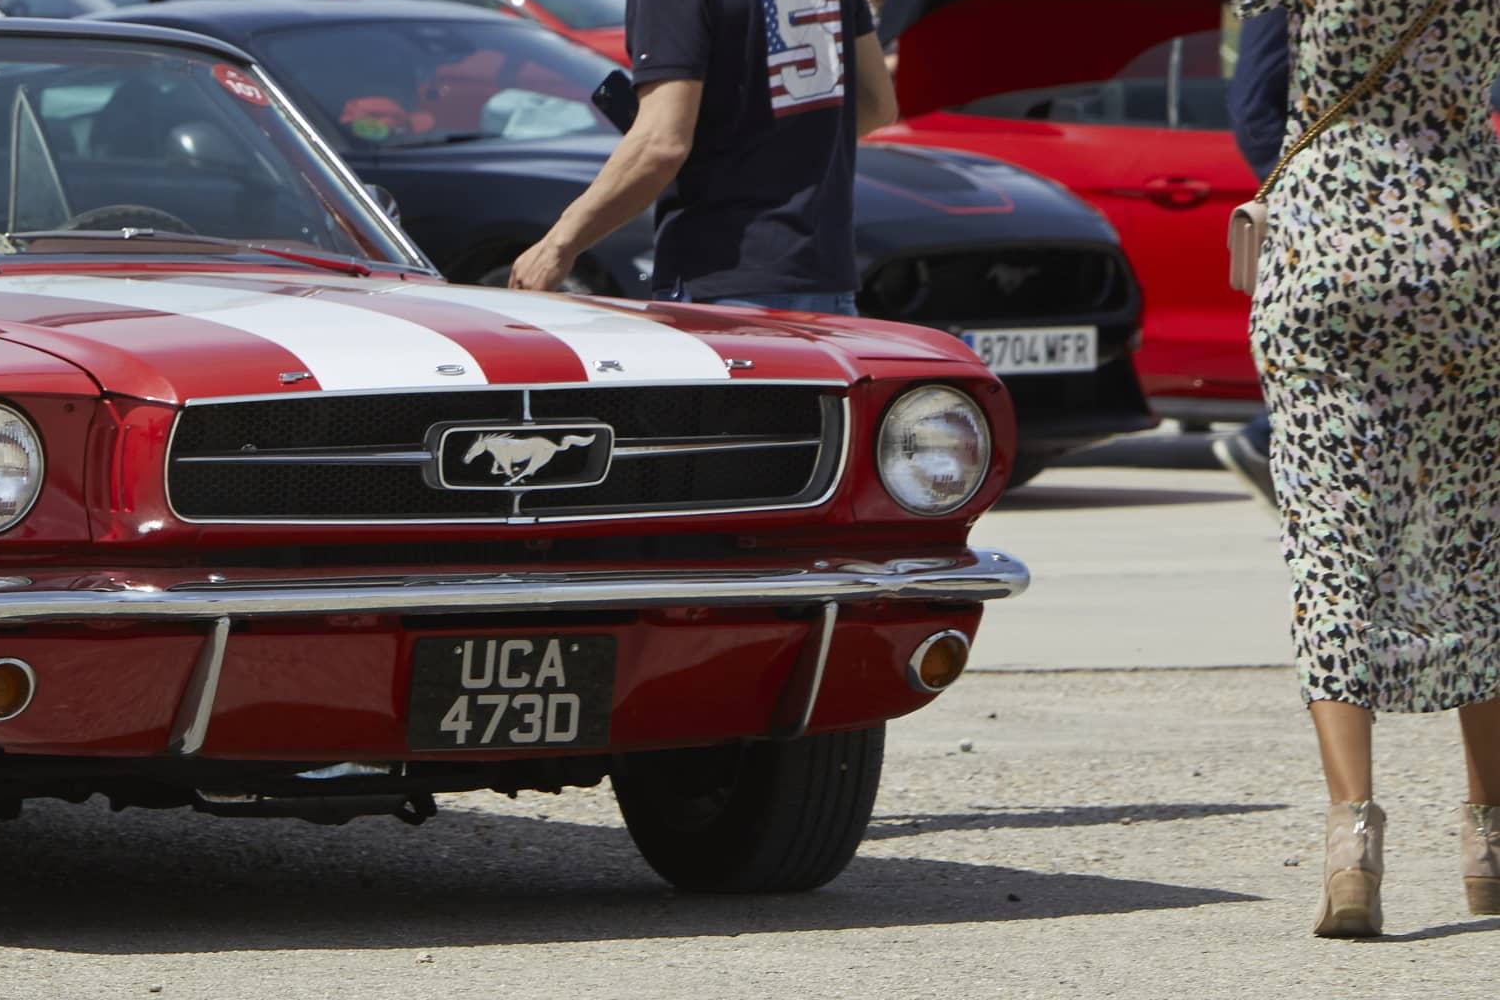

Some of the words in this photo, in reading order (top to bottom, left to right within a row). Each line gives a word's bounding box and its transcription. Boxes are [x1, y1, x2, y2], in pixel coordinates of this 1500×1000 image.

[980, 334, 1039, 366] 8704
[1044, 332, 1089, 365] WFR
[461, 638, 567, 690] UCA
[439, 692, 581, 745] 473D
